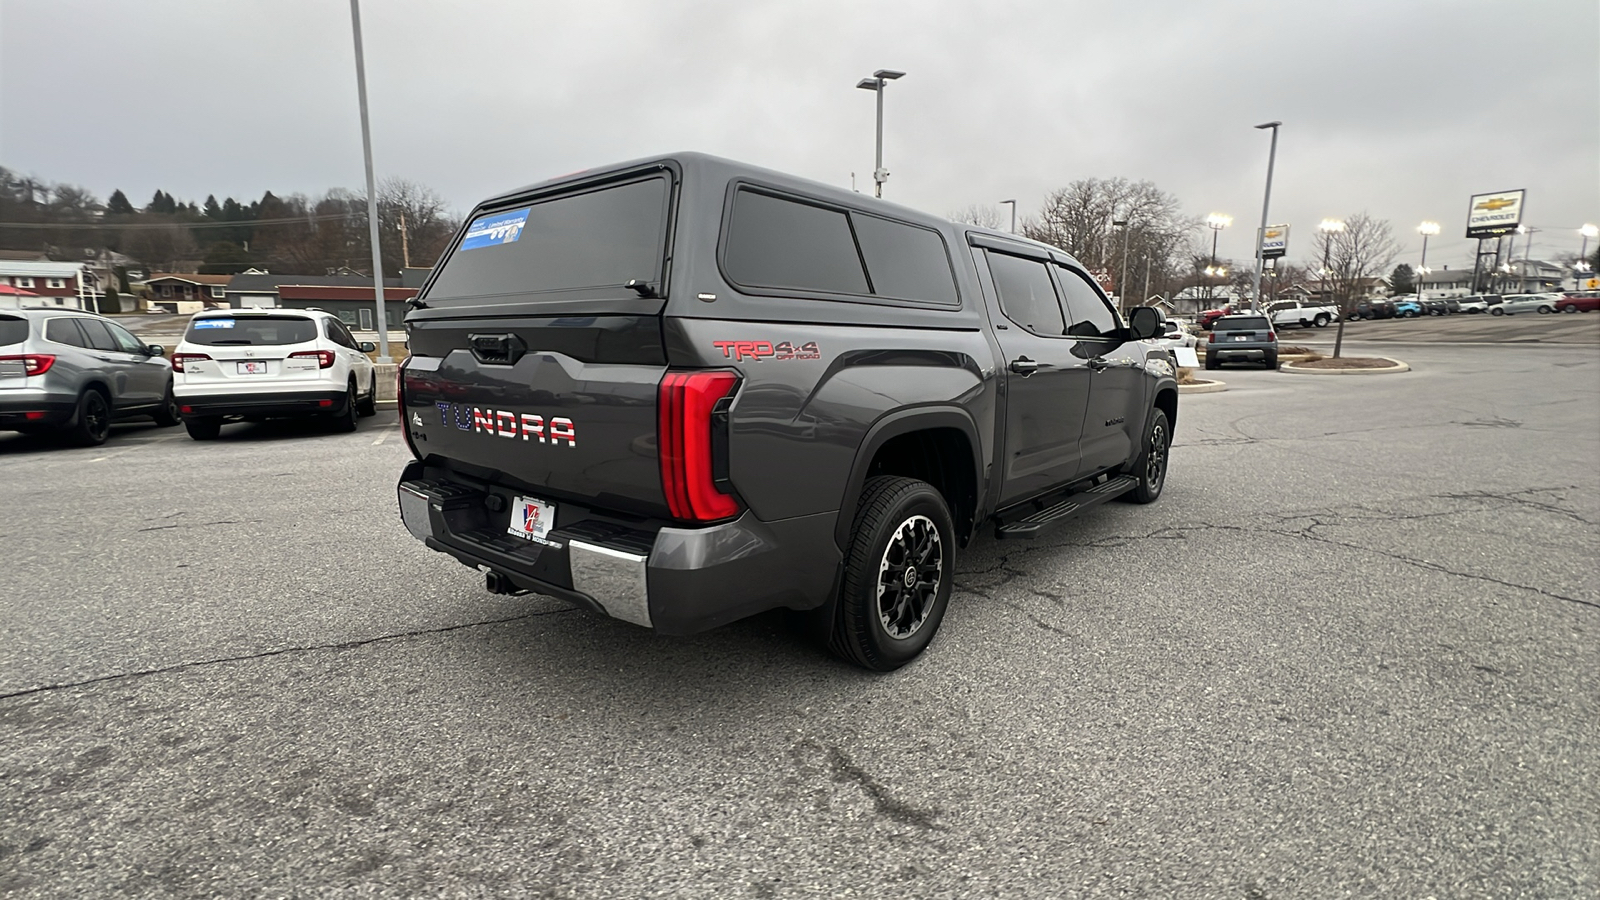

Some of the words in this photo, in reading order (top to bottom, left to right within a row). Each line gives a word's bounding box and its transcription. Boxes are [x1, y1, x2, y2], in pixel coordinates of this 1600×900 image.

[1471, 213, 1516, 223] CHEVROLET
[713, 341, 774, 362] TRD
[435, 401, 577, 448] TUNDRA
